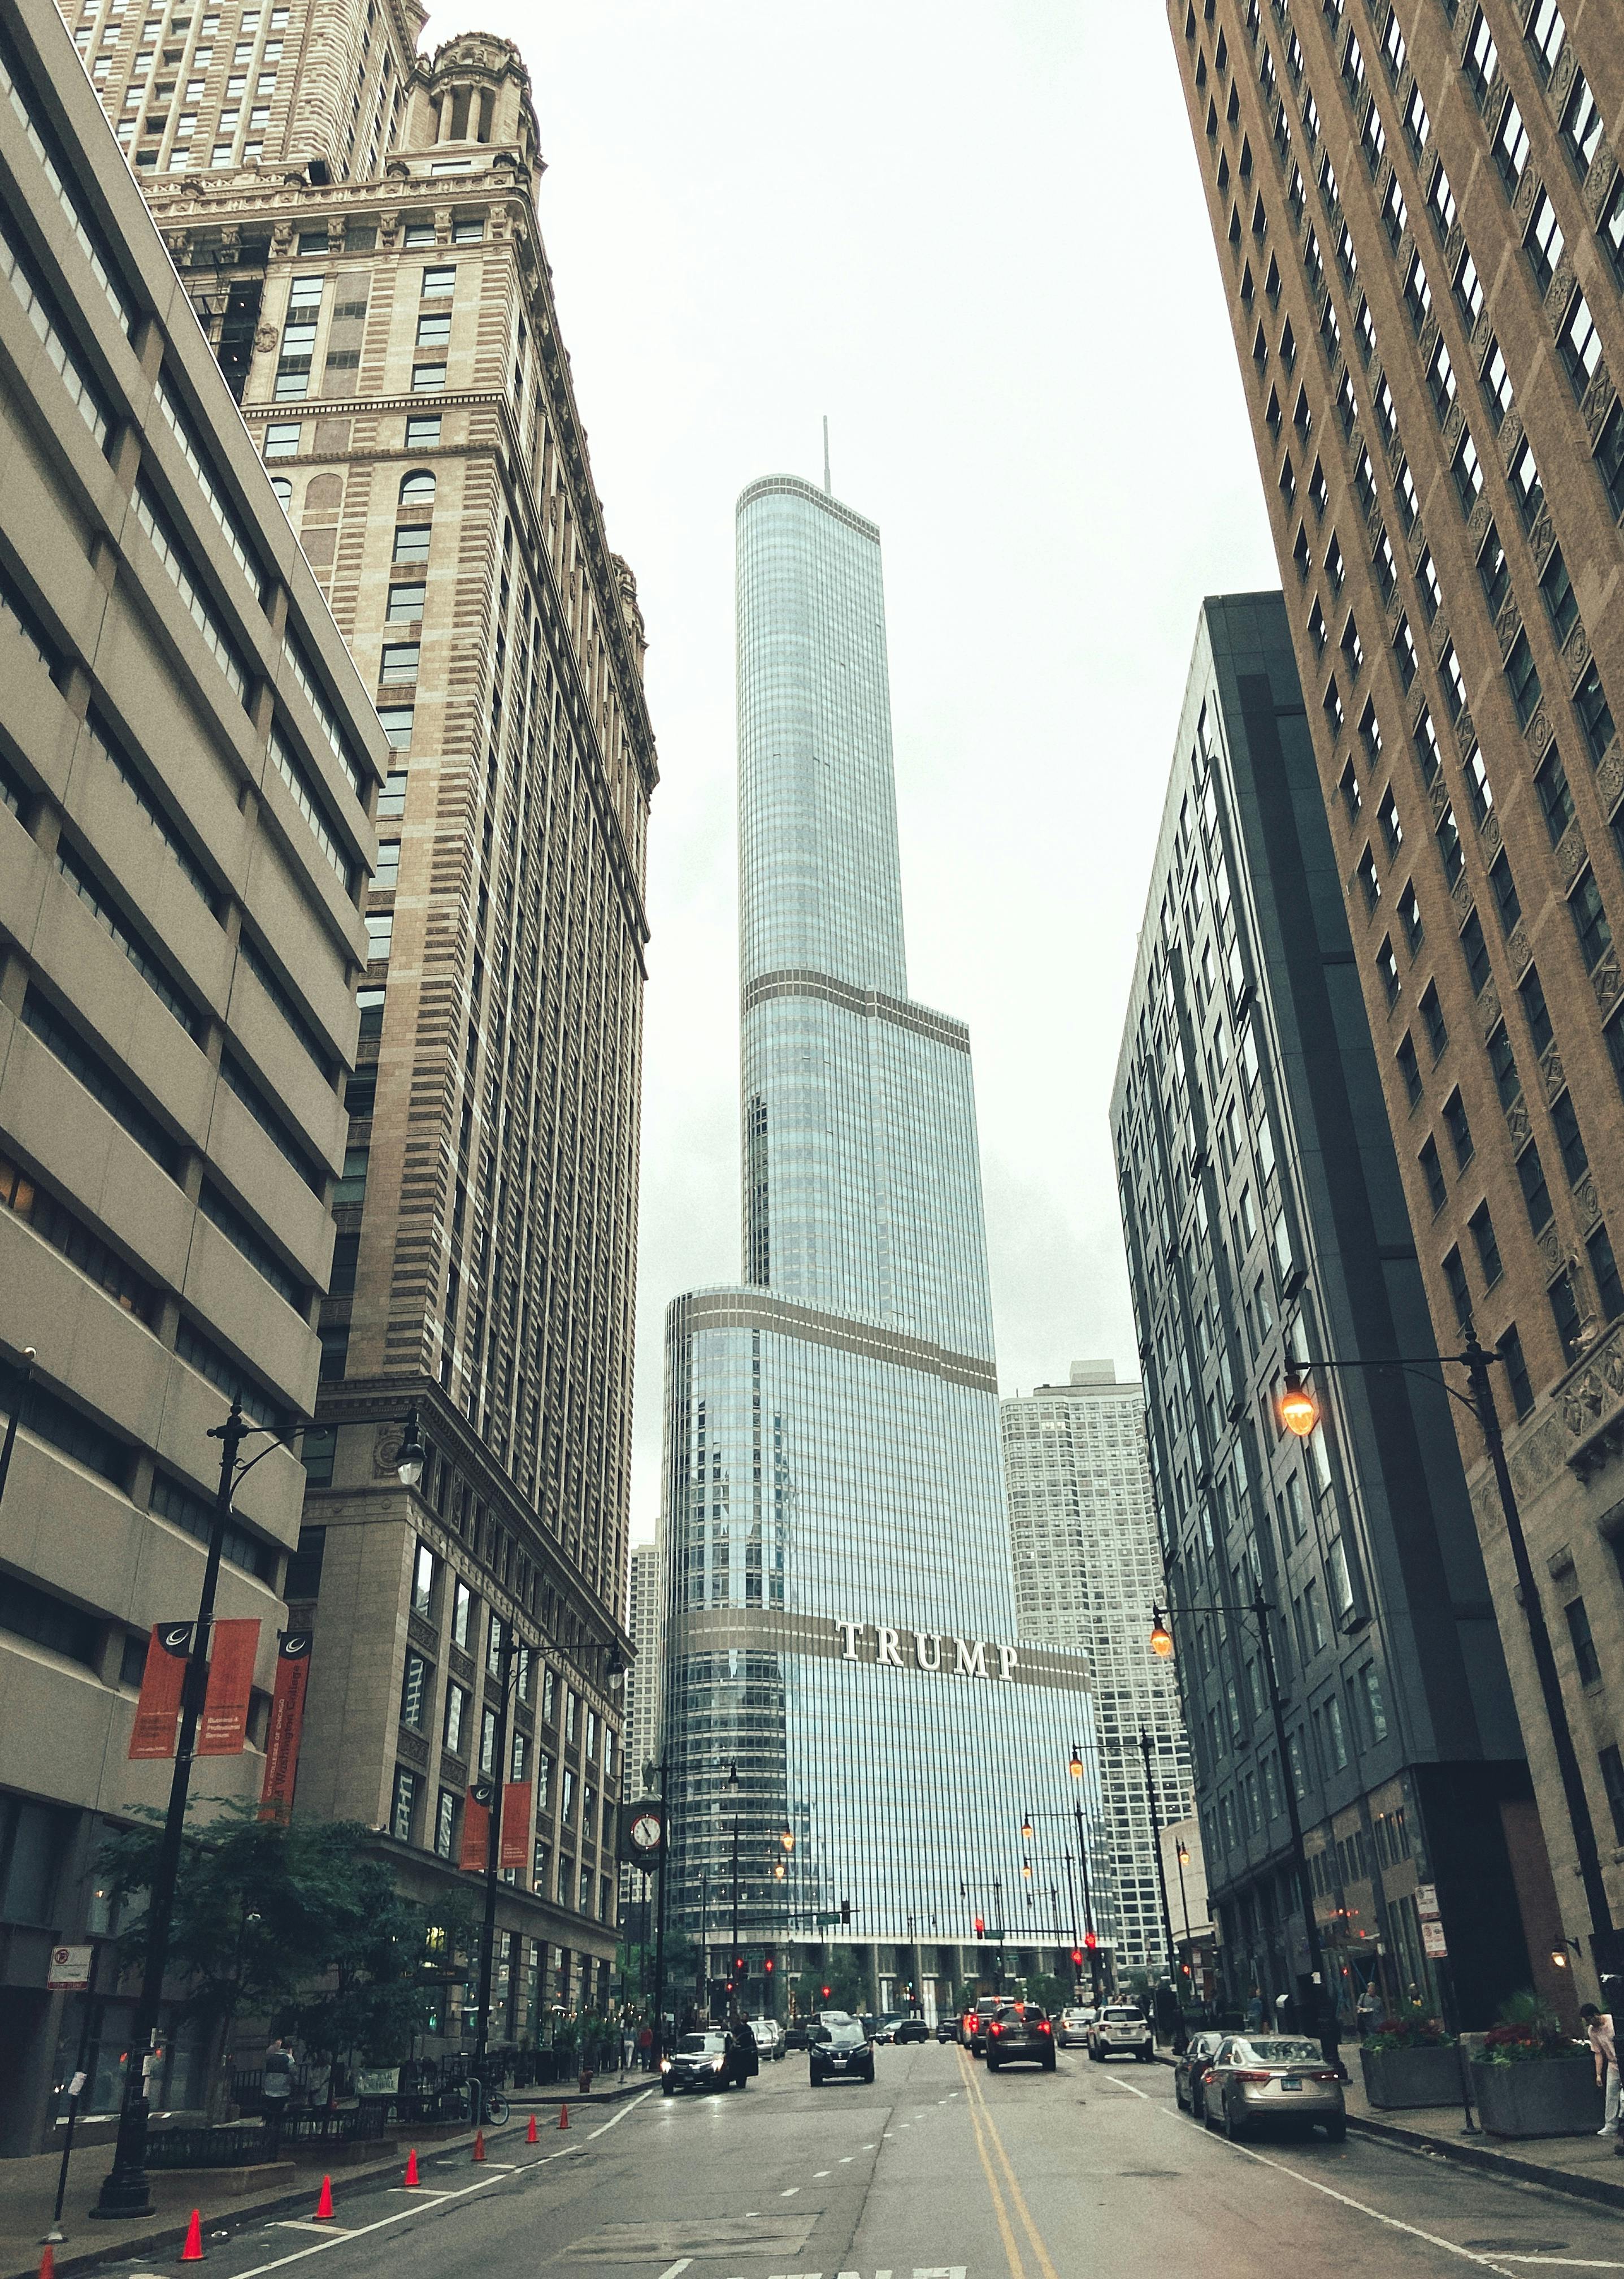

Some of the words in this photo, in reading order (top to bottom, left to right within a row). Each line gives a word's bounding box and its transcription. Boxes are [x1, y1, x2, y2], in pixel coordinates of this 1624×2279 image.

[835, 1619, 1018, 1681] TRUMP
[275, 1714, 293, 1785] Washington
[286, 1665, 301, 1710] College
[276, 1699, 285, 1730] CHICAGO
[275, 1732, 280, 1740] OF
[270, 1743, 279, 1779] COLLEGES
